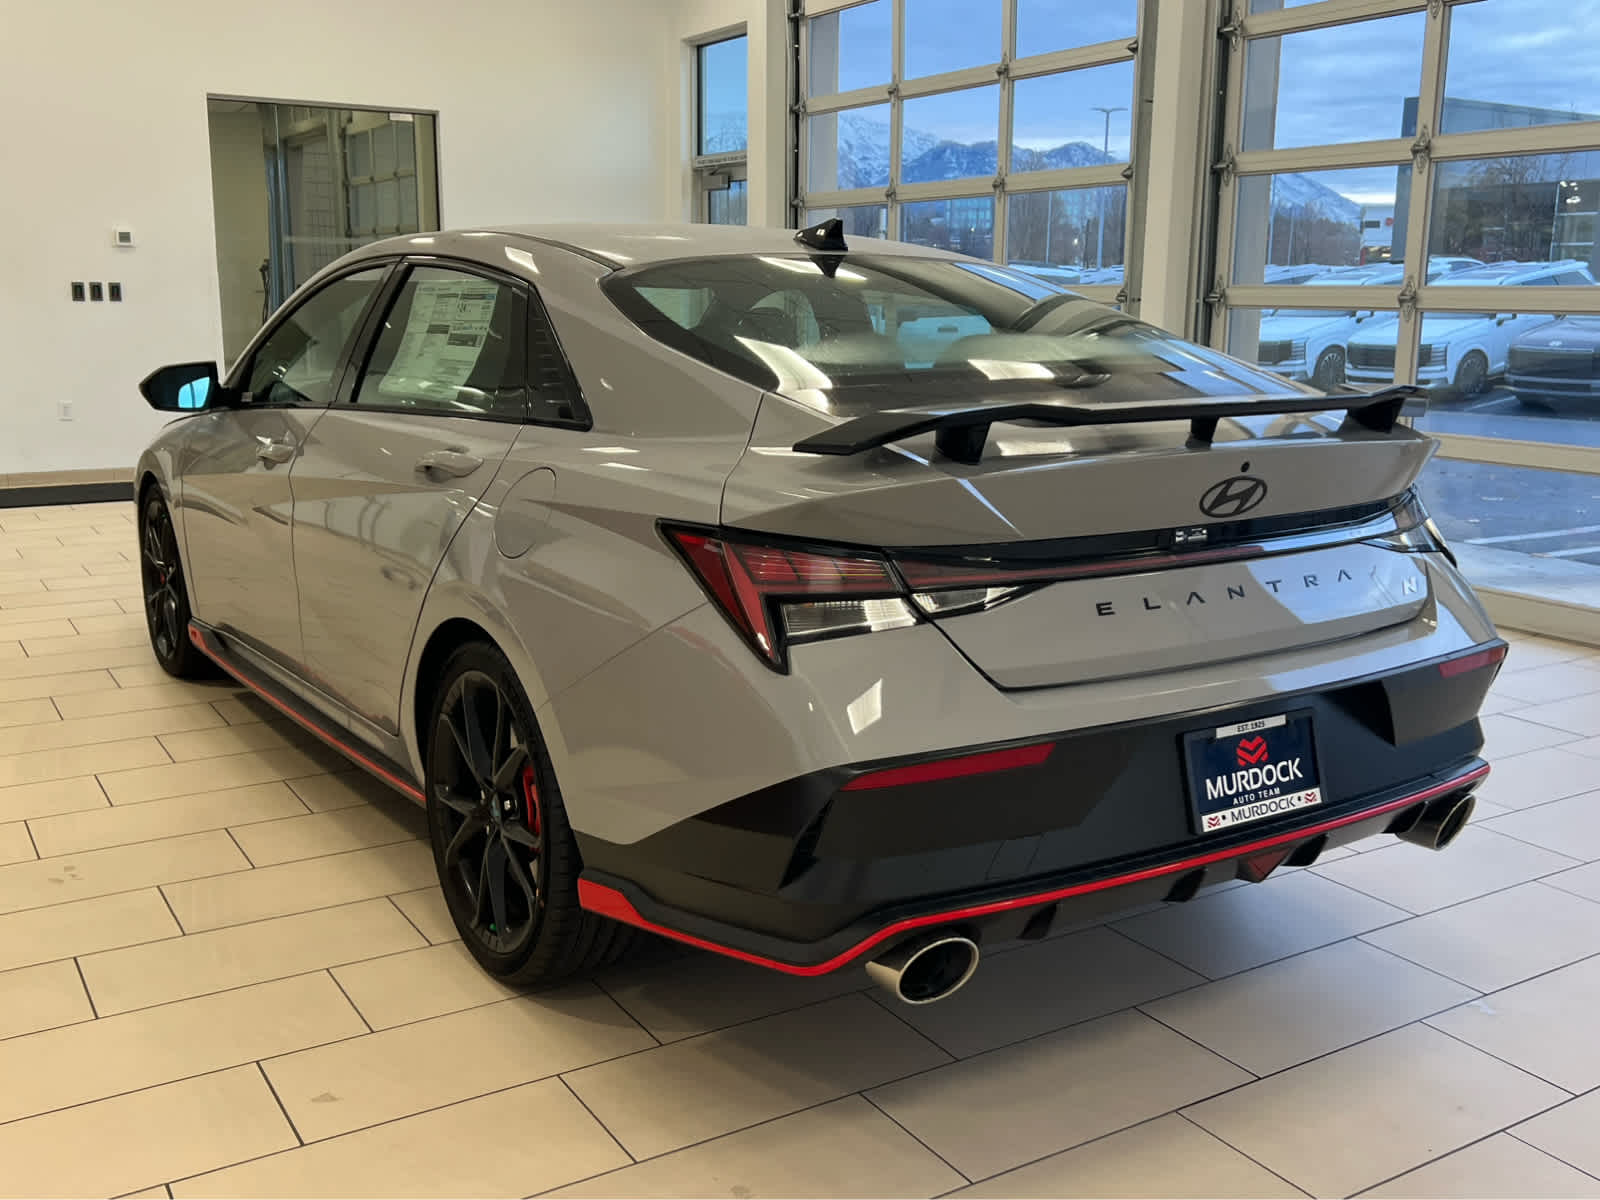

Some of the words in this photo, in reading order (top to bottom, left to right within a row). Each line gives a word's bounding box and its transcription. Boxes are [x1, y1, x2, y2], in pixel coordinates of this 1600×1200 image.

[1095, 568, 1353, 617] ELANTRA
[1401, 576, 1417, 595] N
[1205, 758, 1303, 800] MURDOCK
[1233, 793, 1255, 805] AUTO
[1258, 787, 1281, 798] TEAM
[1230, 796, 1296, 823] MURDOCK
